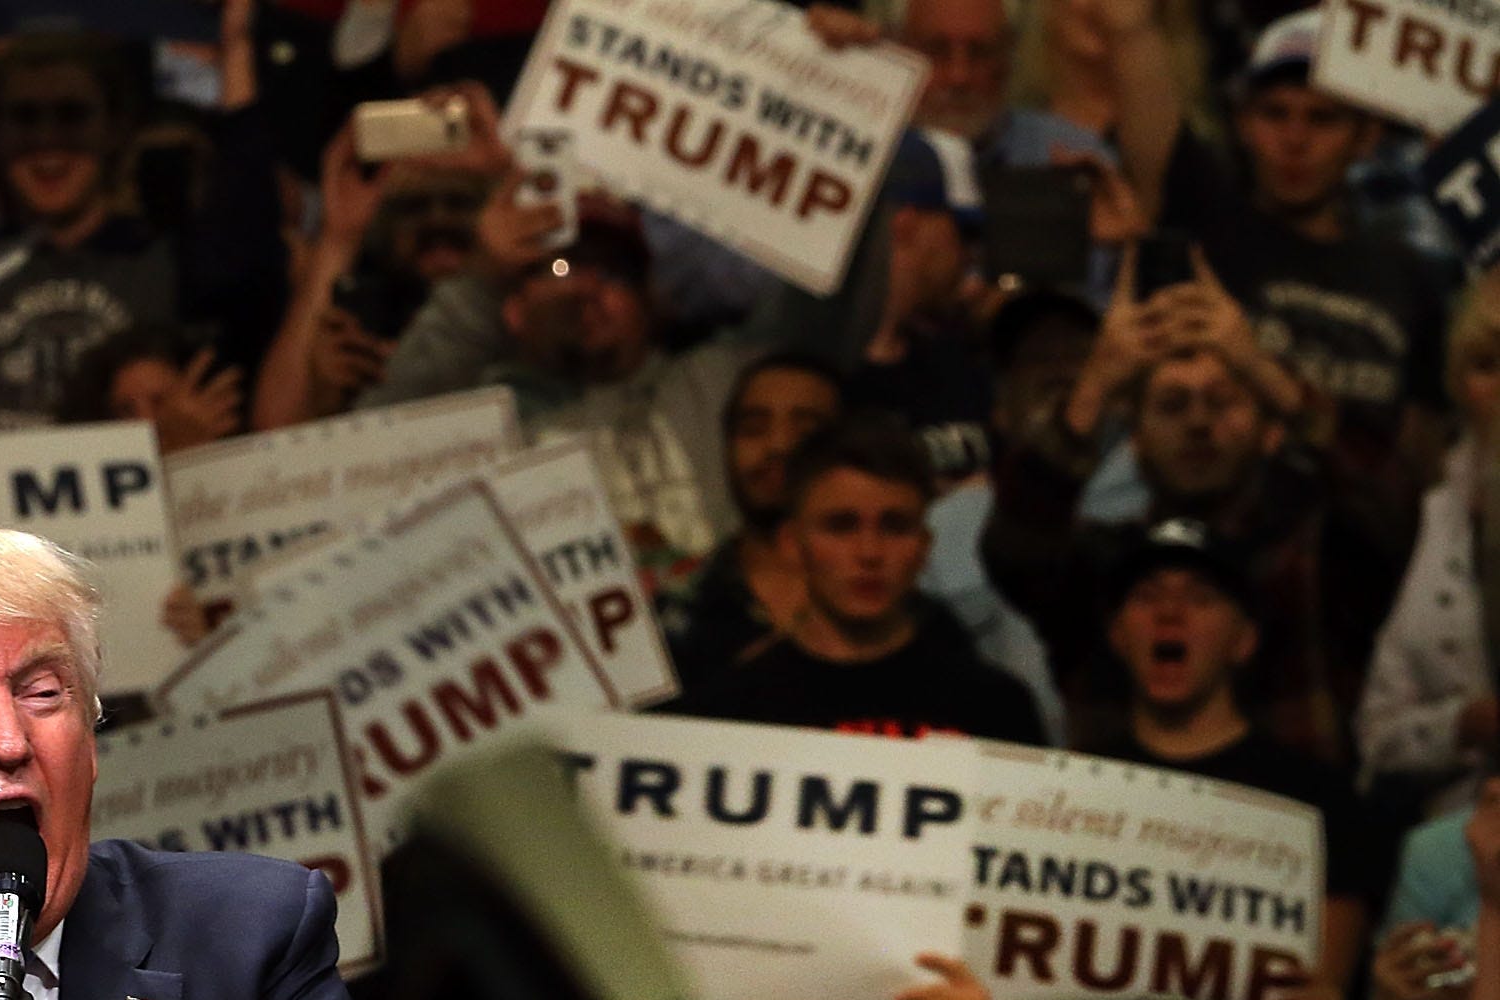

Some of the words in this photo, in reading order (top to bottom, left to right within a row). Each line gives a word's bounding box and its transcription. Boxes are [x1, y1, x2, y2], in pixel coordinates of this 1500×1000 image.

[552, 56, 854, 222] TRUMP
[540, 533, 618, 585] ITH
[1164, 870, 1309, 936] WITH
